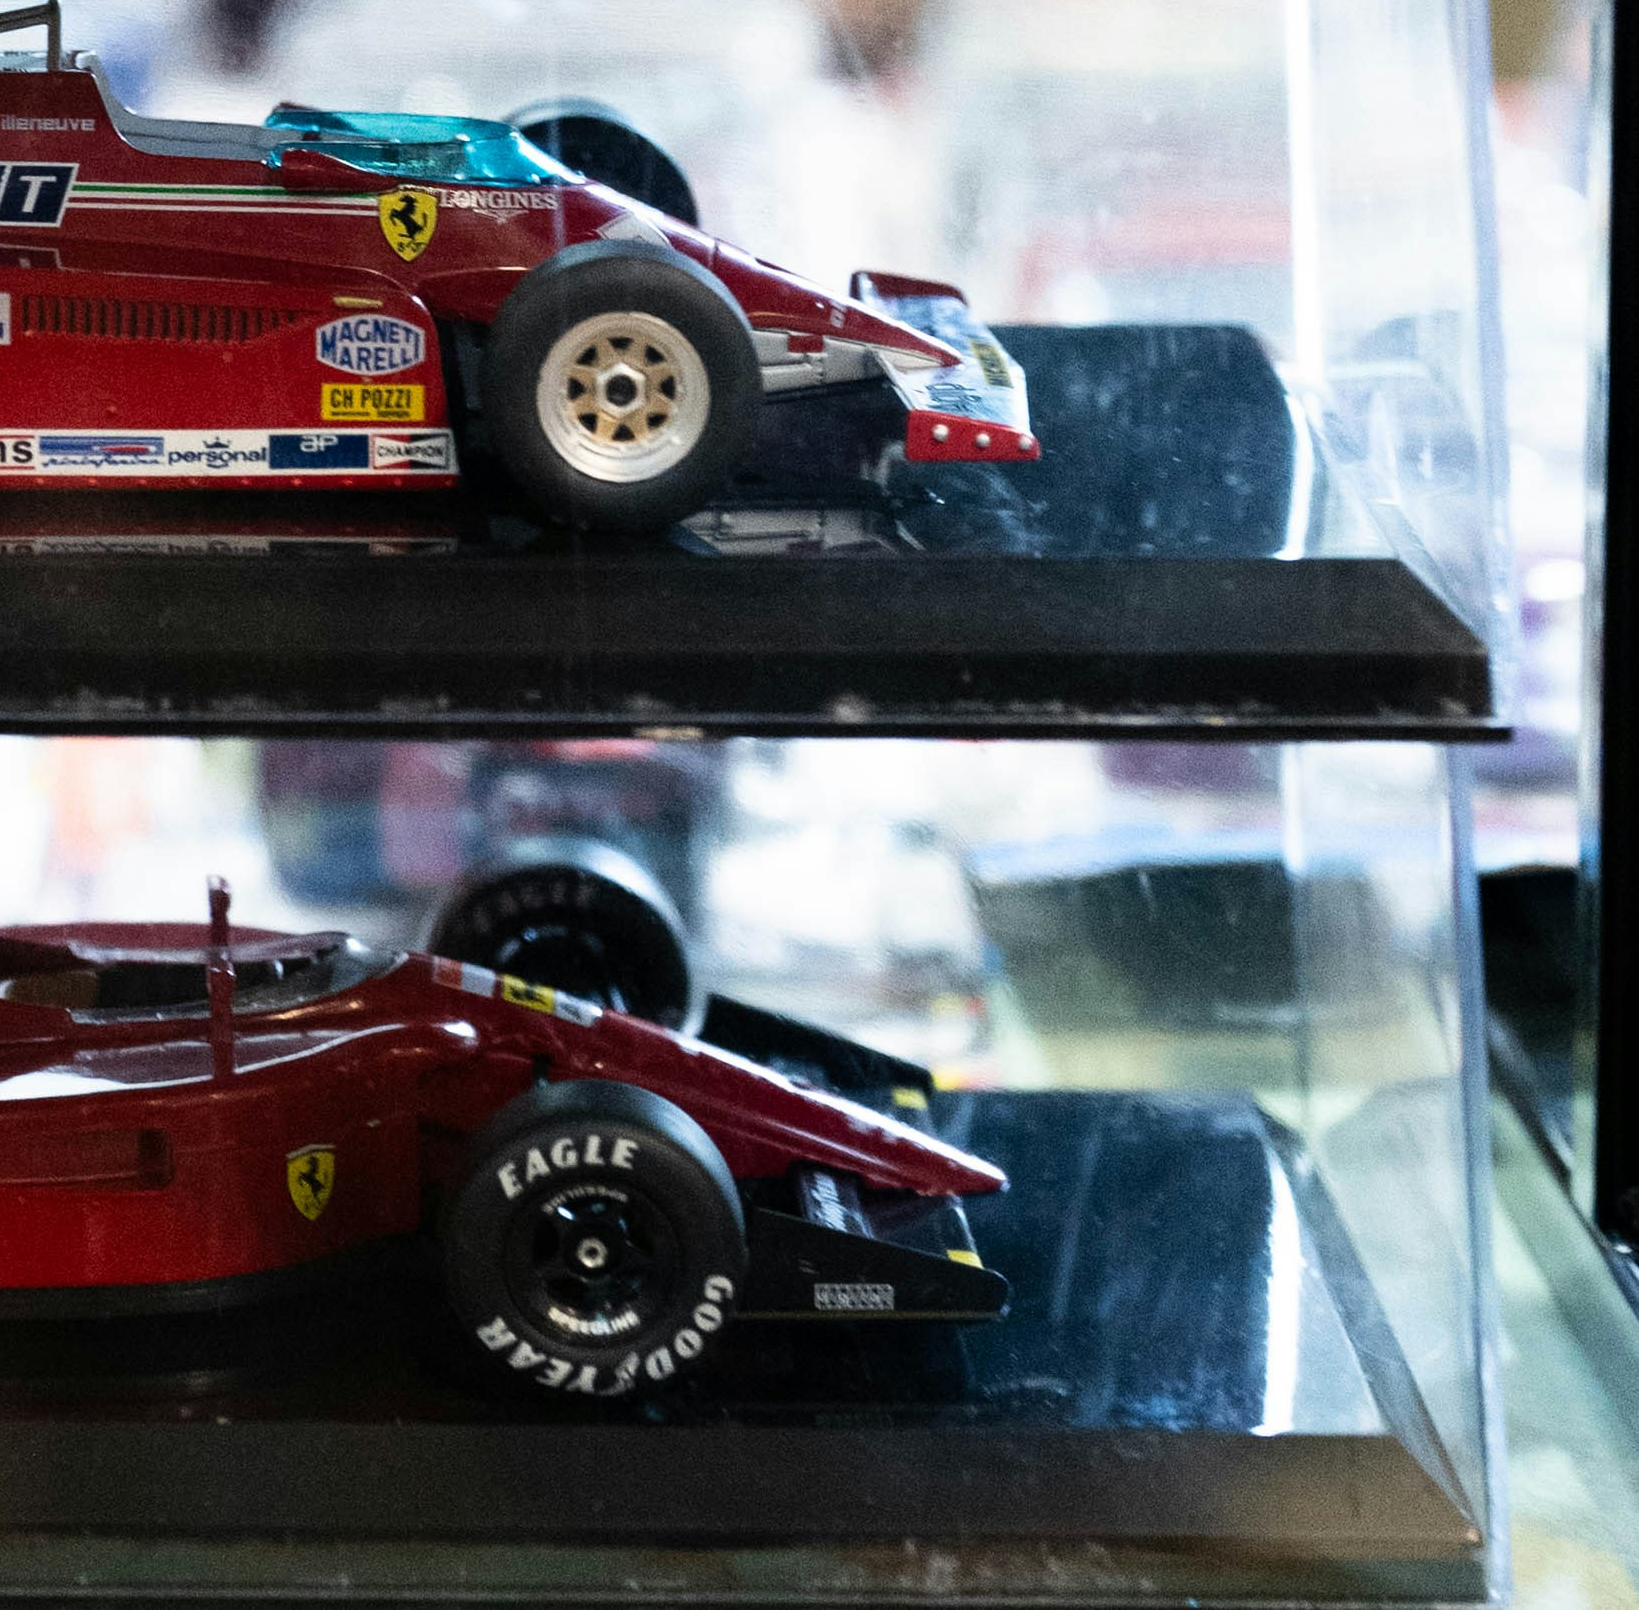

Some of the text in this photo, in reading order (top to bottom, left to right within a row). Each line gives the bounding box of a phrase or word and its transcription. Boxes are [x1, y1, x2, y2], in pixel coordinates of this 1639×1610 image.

[438, 188, 558, 210] LONGINES
[320, 319, 421, 349] MAGNETI
[320, 344, 421, 372] MARELLI
[330, 388, 411, 409] CH POZZI
[168, 446, 267, 468] personal
[377, 445, 444, 458] CHAMPION
[497, 1134, 640, 1200] EAGLE
[476, 1274, 735, 1397] GOODYEAR
